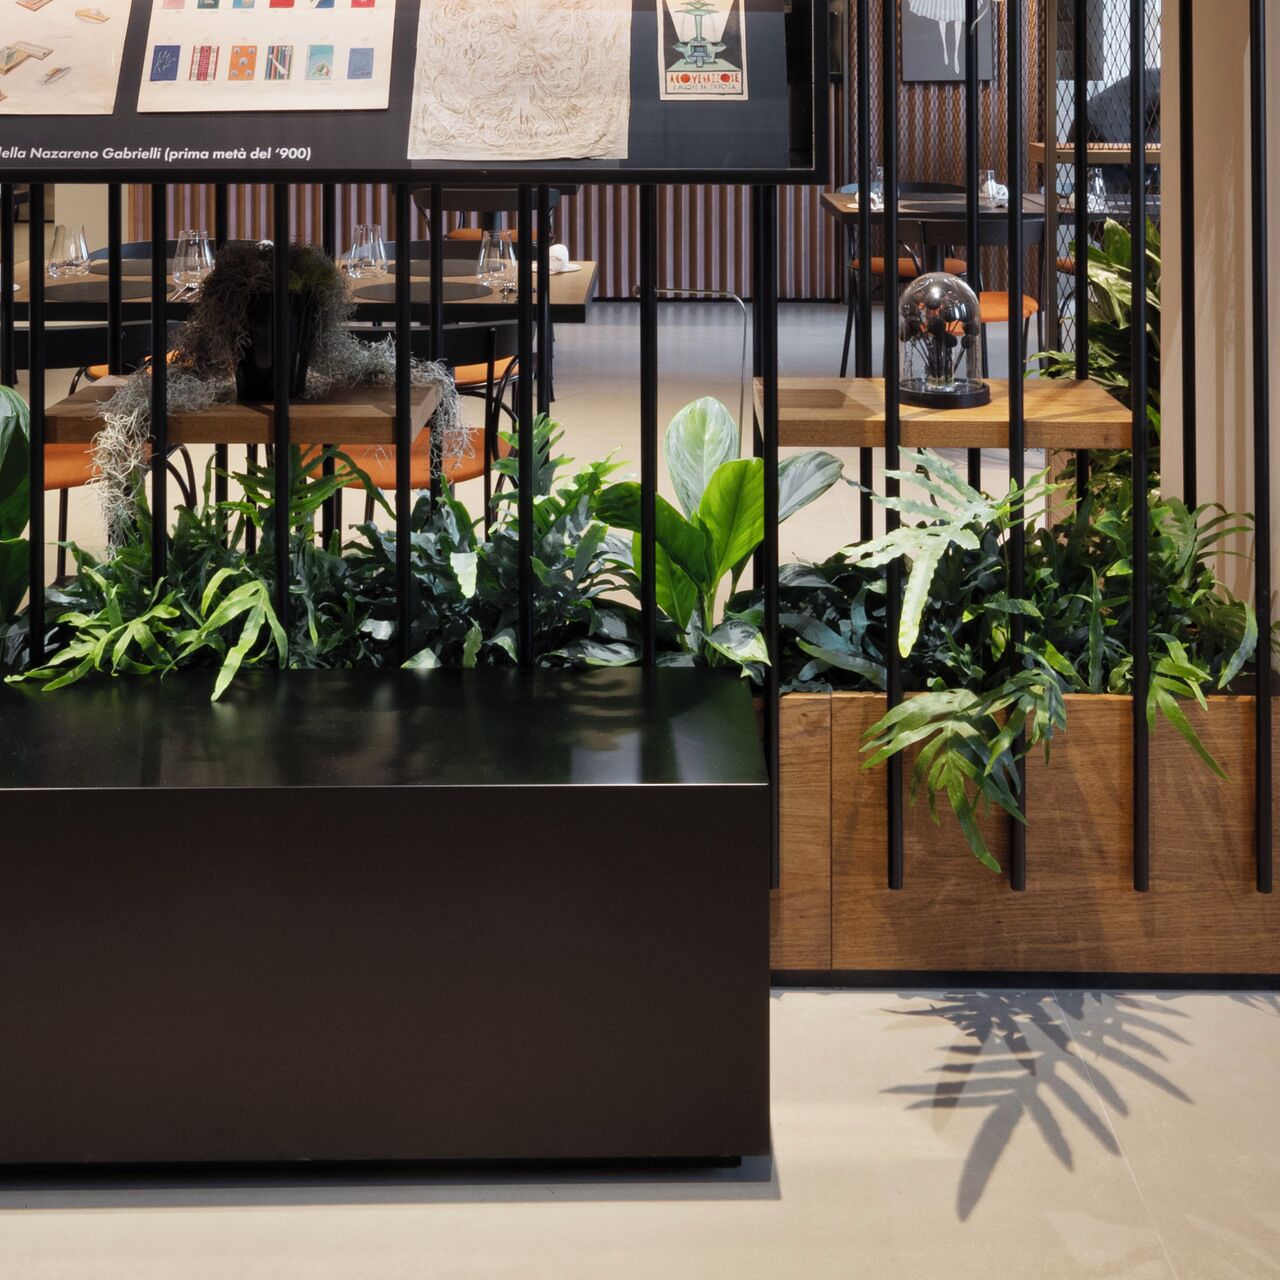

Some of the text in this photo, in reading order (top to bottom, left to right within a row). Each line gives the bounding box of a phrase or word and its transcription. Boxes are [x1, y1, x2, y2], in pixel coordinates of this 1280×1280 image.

[29, 147, 99, 160] Nazareno
[102, 147, 162, 160] Gabrielli
[164, 147, 210, 163] (prima
[212, 147, 247, 160] metà
[250, 146, 272, 160] del
